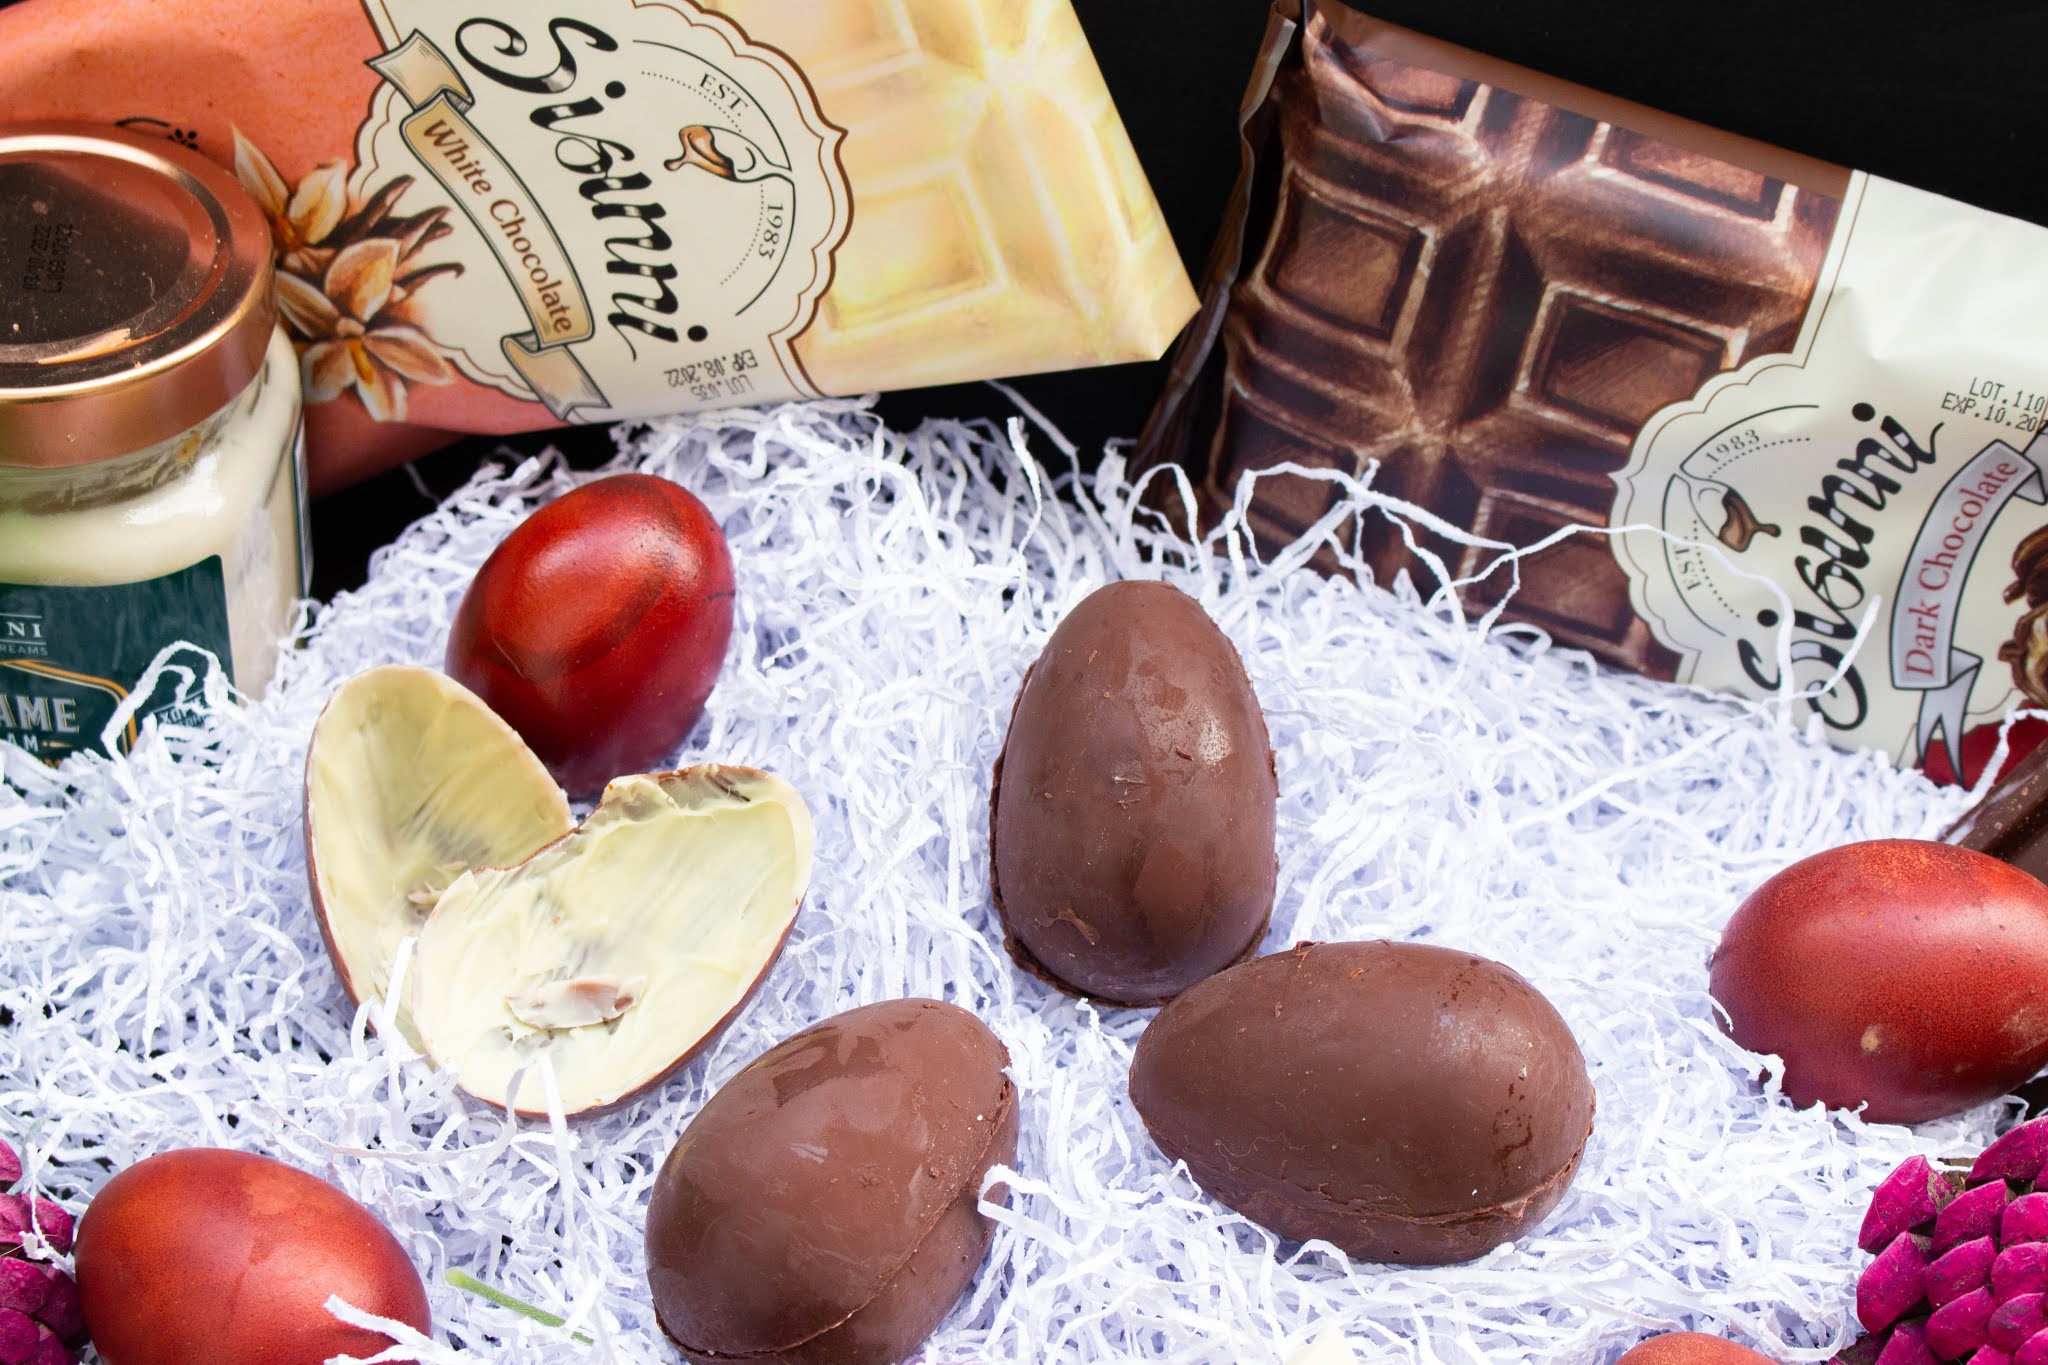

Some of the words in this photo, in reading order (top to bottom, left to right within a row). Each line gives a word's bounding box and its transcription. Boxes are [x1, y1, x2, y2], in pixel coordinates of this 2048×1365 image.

[698, 72, 750, 118] EST.
[422, 118, 493, 195] White
[489, 198, 573, 334] Chocolate
[757, 201, 785, 261] 1983
[1968, 377, 2046, 414] LOT.110
[1705, 428, 1761, 464] 1983
[1918, 461, 2019, 591] Chocolate
[1905, 602, 1940, 678] Dark
